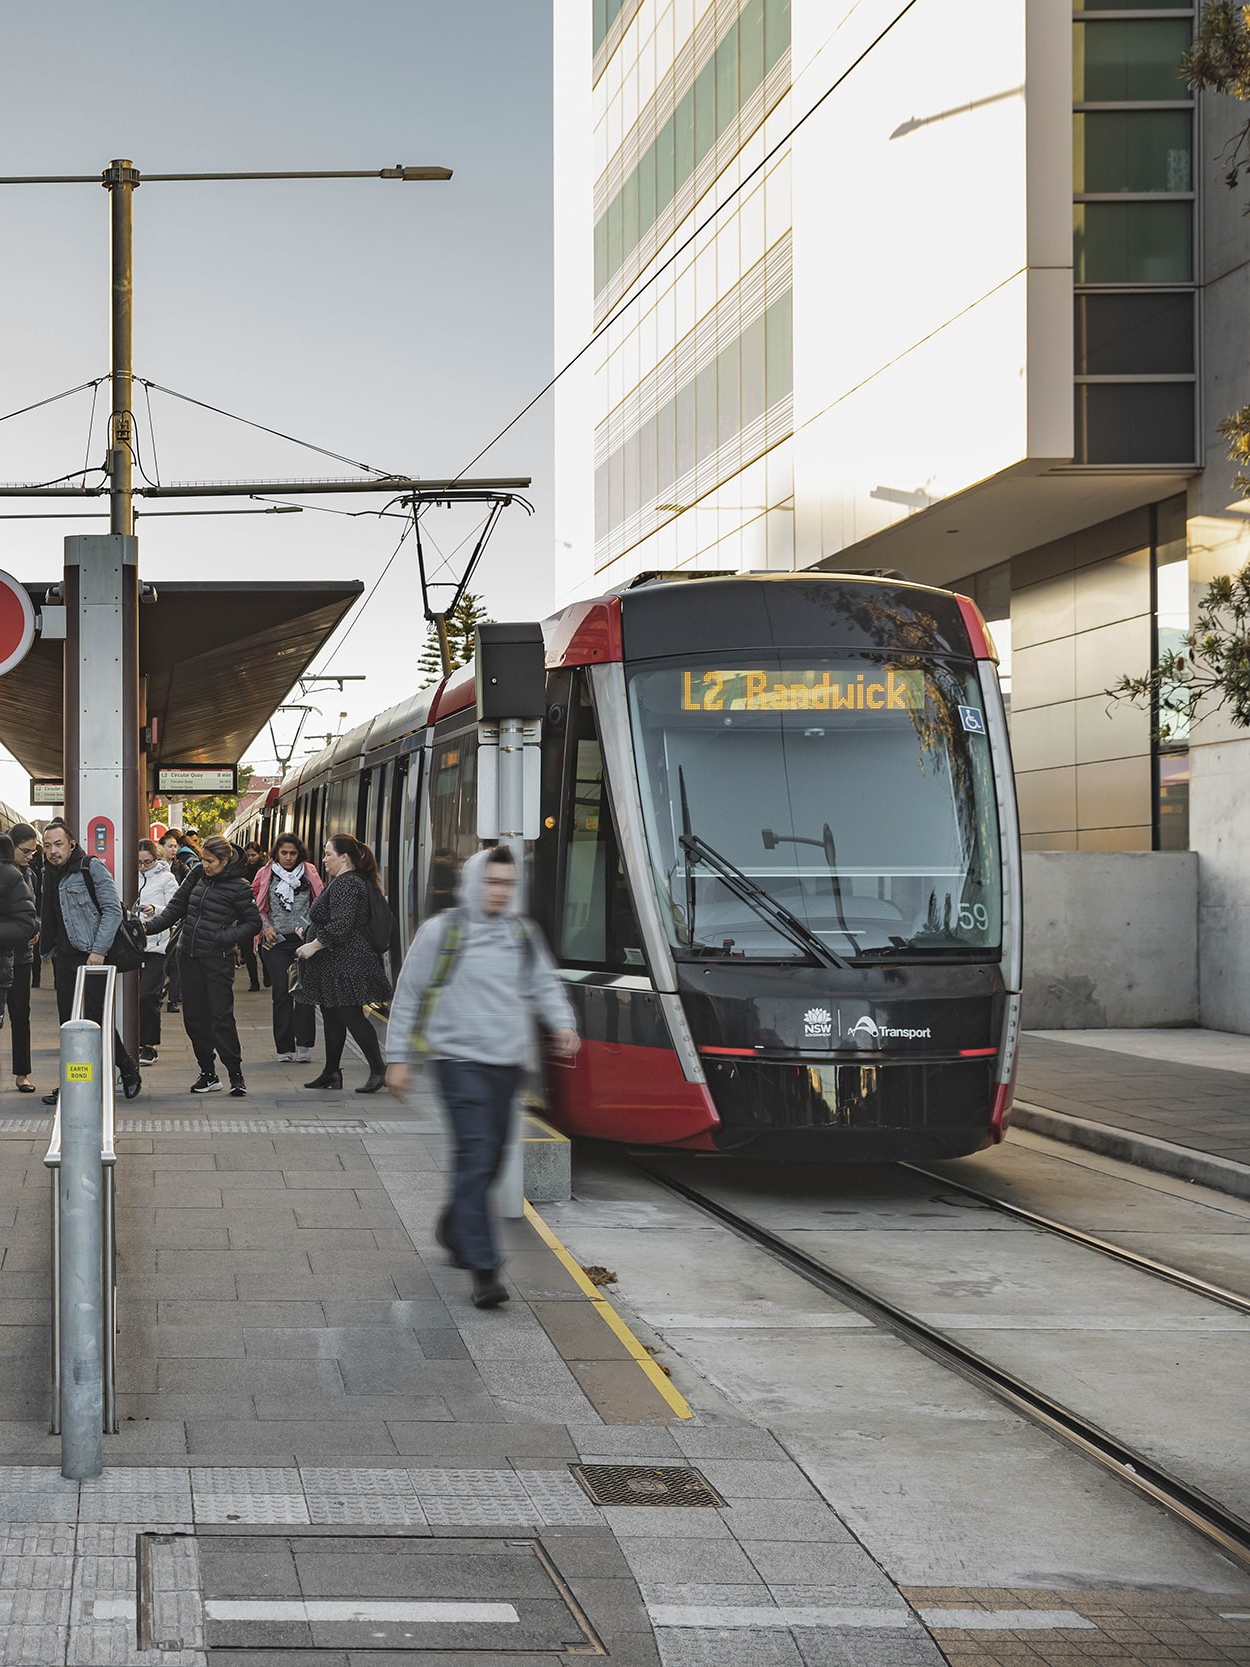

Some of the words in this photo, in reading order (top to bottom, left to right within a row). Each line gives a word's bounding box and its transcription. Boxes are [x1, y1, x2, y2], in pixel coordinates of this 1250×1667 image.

[683, 671, 724, 710] L2
[746, 671, 906, 710] Randwick
[153, 827, 161, 841] L
[958, 903, 988, 930] 59
[804, 1024, 832, 1033] NSW
[878, 1026, 931, 1039] Transport
